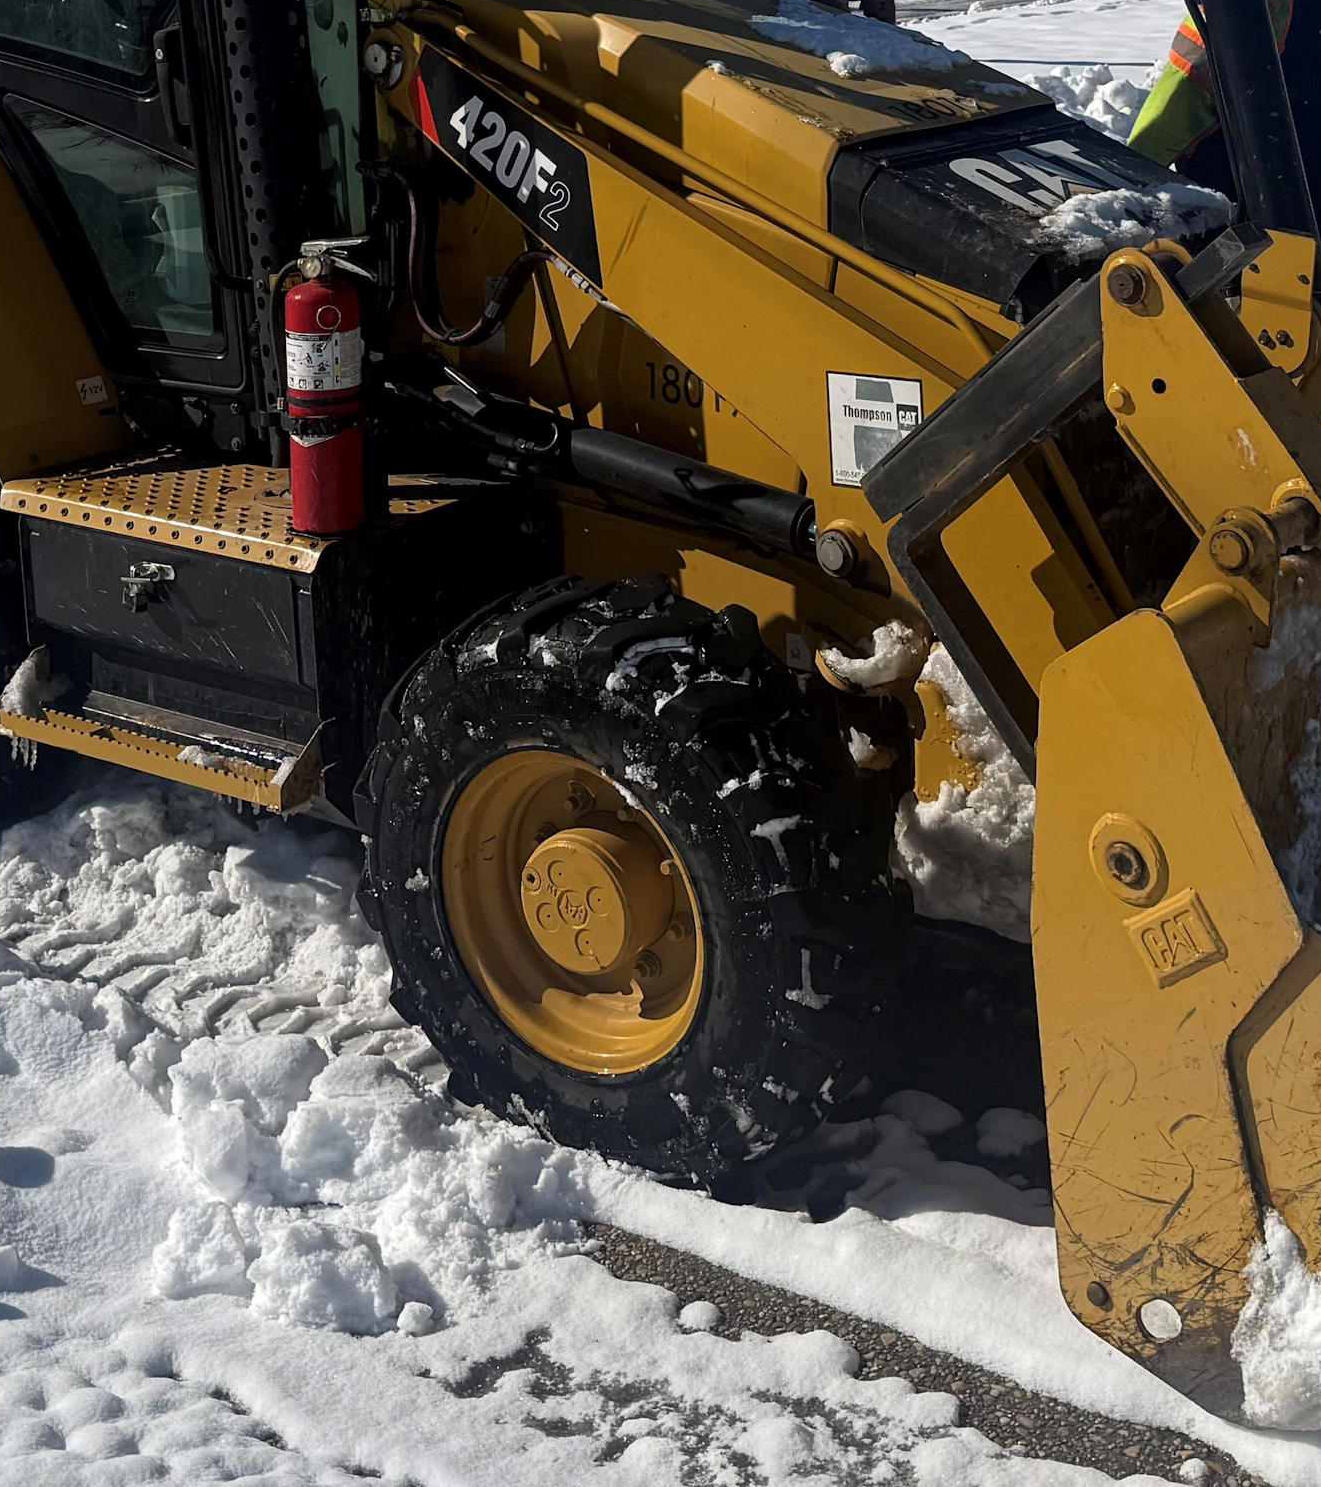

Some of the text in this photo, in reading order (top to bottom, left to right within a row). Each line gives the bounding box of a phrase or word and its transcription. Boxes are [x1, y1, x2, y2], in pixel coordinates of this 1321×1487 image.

[449, 95, 571, 232] 420F2
[949, 139, 1141, 216] CAT
[842, 404, 917, 426] Thompson CAT
[1140, 908, 1203, 972] CAT
